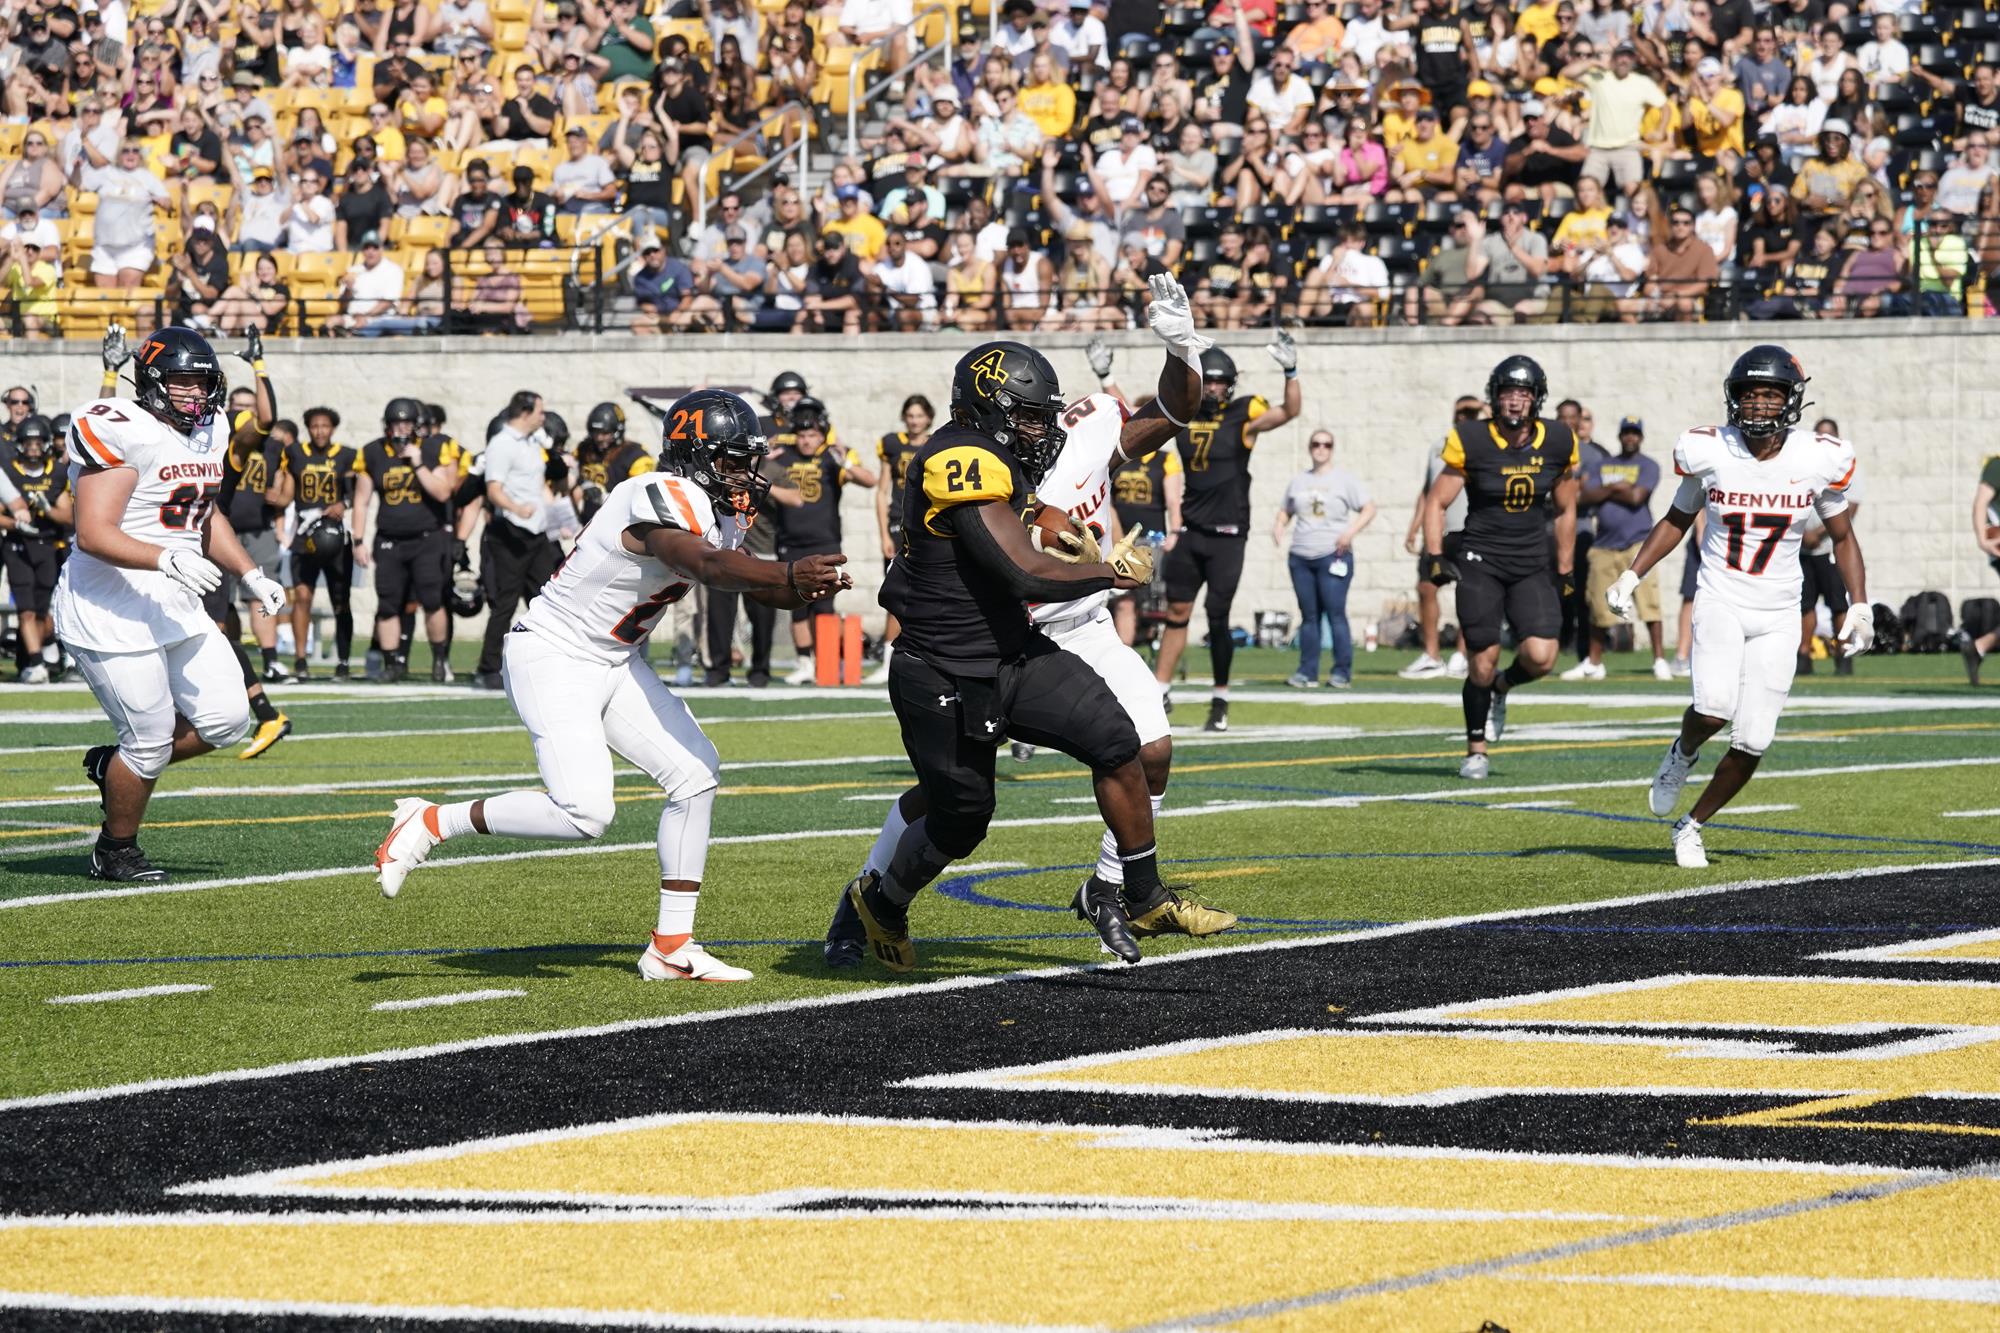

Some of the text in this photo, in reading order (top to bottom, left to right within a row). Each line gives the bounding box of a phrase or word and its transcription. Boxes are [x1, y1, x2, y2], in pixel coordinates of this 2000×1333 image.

[86, 403, 132, 423] 97
[669, 409, 709, 441] 21
[1188, 428, 1214, 472] 7
[301, 469, 338, 504] 84
[945, 457, 983, 493] 24
[1503, 473, 1536, 513] 0
[1707, 487, 1816, 509] GREENVILLE
[1721, 511, 1793, 576] 17
